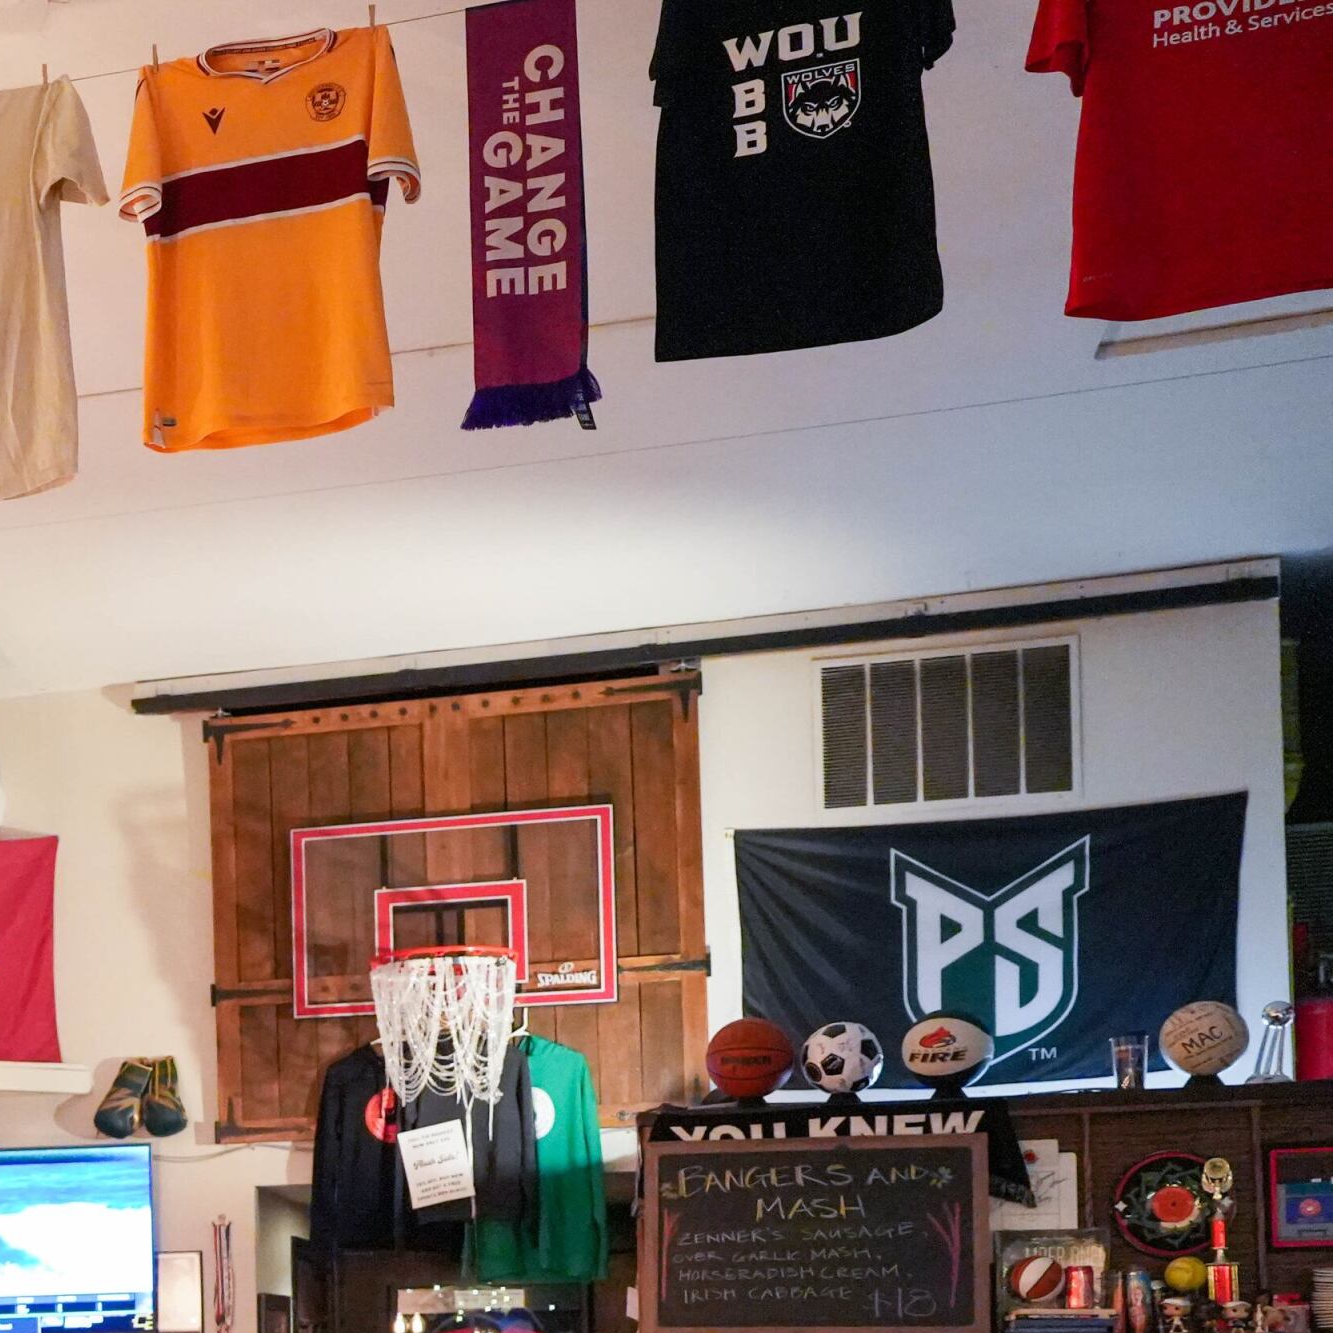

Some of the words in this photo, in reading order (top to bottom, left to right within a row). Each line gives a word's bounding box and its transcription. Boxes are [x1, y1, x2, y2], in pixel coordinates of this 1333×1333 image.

[1152, 23, 1221, 49] Health
[1225, 19, 1243, 36] &
[1248, 2, 1333, 32] Services
[722, 11, 863, 72] WOU
[786, 63, 855, 84] WOLVES
[501, 76, 520, 124] THE
[523, 44, 567, 296] CHANGE
[482, 130, 525, 298] GAME
[536, 970, 598, 988] SPALDING
[1028, 1047, 1058, 1061] TM
[1181, 1025, 1224, 1054] MAC
[908, 1049, 967, 1064] FIRE
[678, 1164, 854, 1198] BANGERS
[865, 1165, 929, 1185] AND
[756, 1194, 867, 1223] MASH
[673, 1251, 724, 1264] OVER
[732, 1249, 800, 1263] GARLIC
[684, 1287, 736, 1304] IRISH
[748, 1287, 853, 1303] CABBAGE
